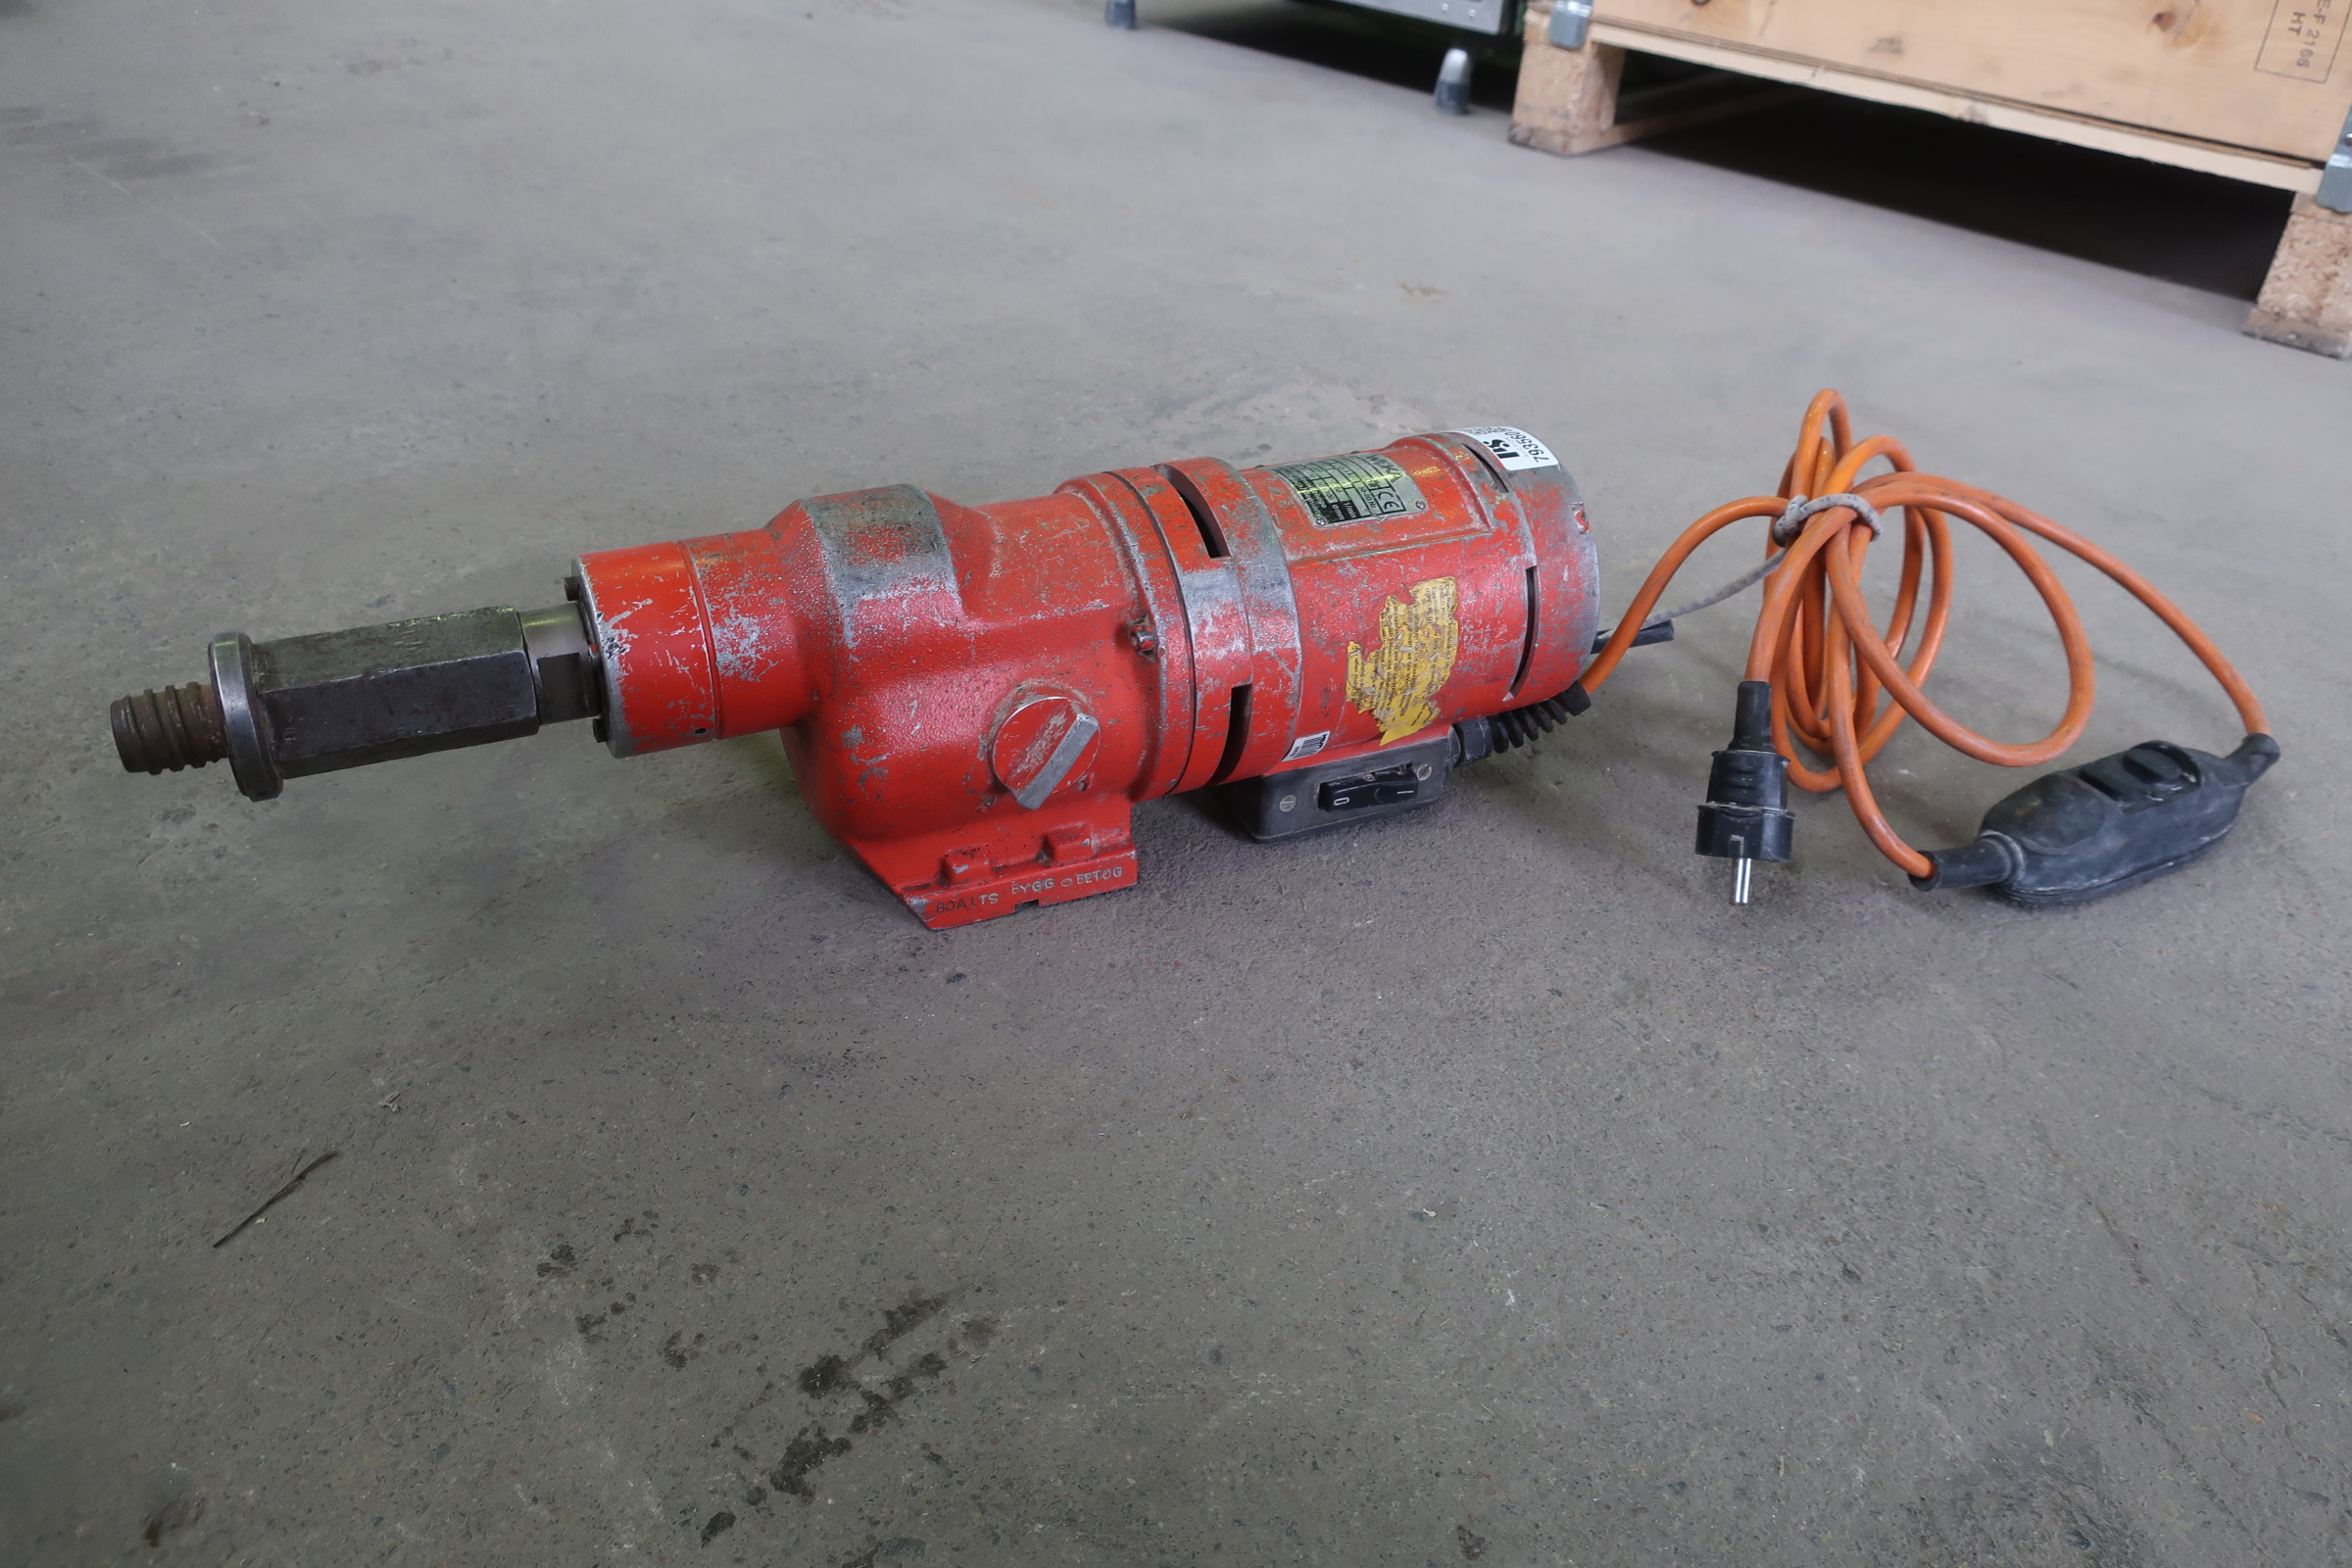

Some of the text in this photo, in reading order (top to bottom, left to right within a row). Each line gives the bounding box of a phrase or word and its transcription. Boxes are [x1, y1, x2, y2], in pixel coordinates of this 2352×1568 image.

[2288, 12, 2306, 36] HT
[1504, 431, 1550, 464] 793560
[1378, 491, 1400, 510] CE
[1010, 877, 1055, 895] BYGG
